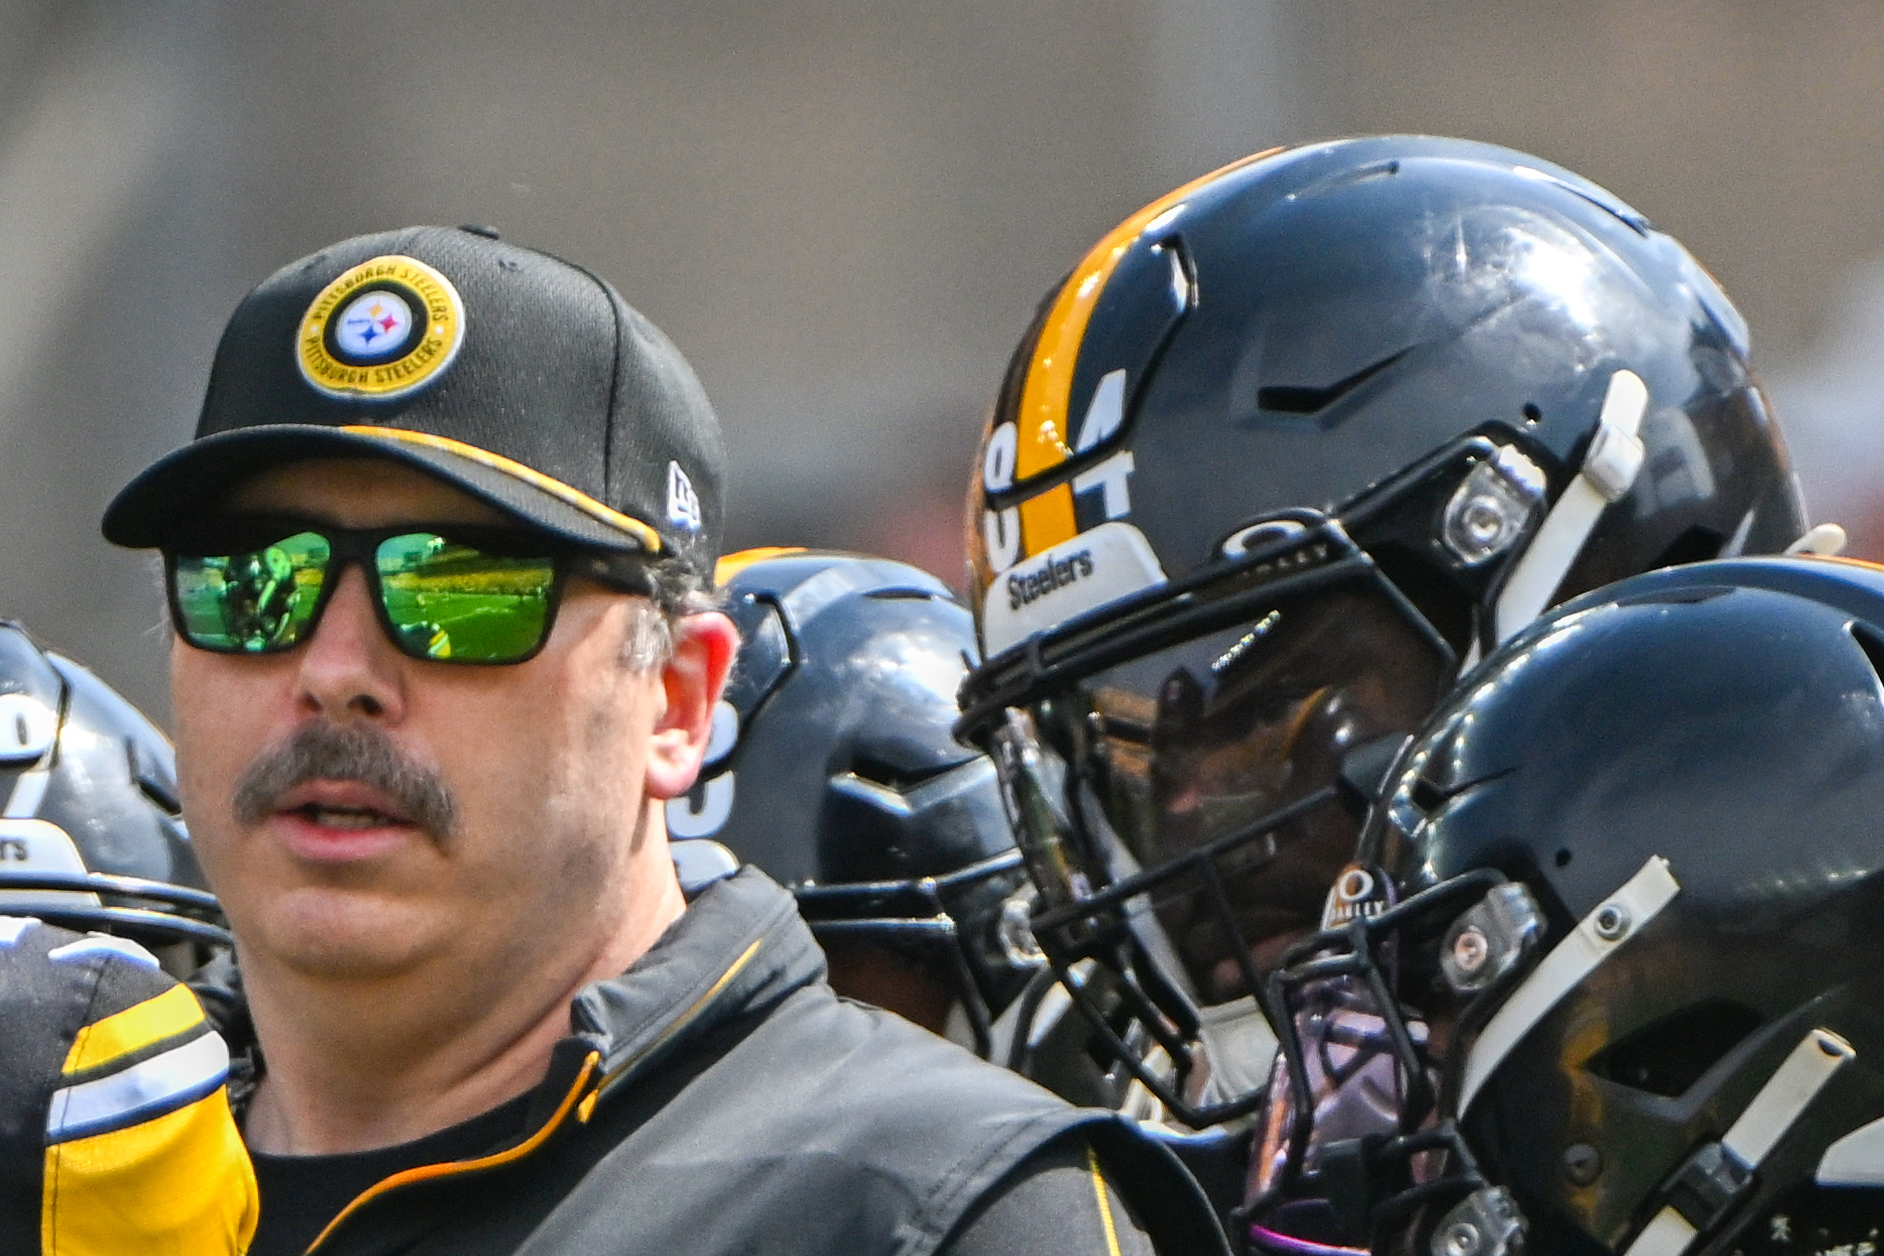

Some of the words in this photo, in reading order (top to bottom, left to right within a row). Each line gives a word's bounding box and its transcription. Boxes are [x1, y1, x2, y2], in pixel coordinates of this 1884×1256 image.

[313, 264, 397, 320] PITTSBURGH
[399, 266, 449, 322] STEELERS
[305, 335, 369, 383] PITTSBURGH
[375, 337, 443, 384] STEELERS
[1008, 549, 1094, 610] Steelers
